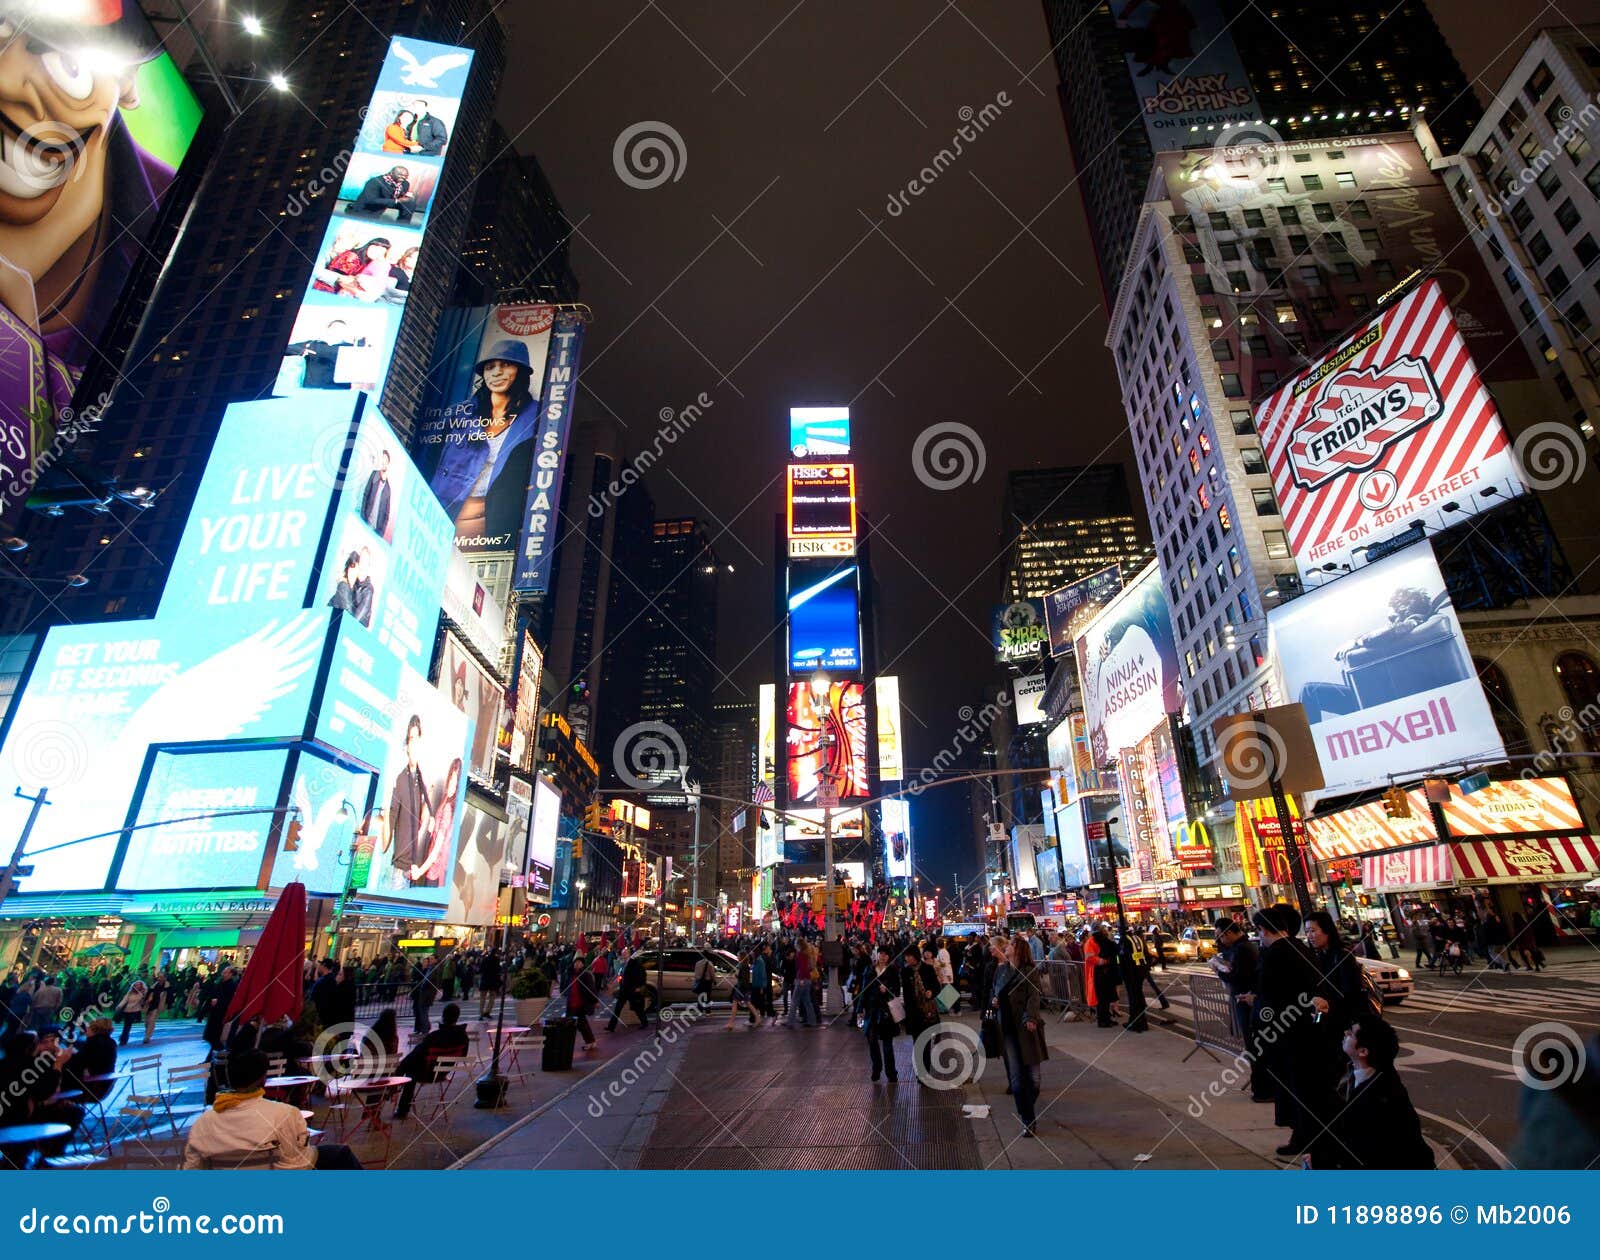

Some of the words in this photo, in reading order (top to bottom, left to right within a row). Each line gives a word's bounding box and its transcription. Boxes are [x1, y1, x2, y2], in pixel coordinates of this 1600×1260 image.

[1157, 73, 1228, 97] MARY
[1144, 87, 1250, 115] POPPINS
[1153, 119, 1176, 129] ON
[1180, 112, 1254, 127] BROADWAY
[547, 333, 575, 420] TIMES
[455, 404, 474, 415] PC
[1337, 399, 1362, 418] T.G.I.
[423, 419, 449, 431] and
[449, 415, 505, 429] Windows
[509, 414, 517, 426] 7
[419, 433, 442, 444] was
[445, 432, 465, 446] my
[230, 462, 320, 505] LIVE
[793, 468, 828, 479] HSBC
[525, 431, 559, 556] SQUARE
[1308, 536, 1345, 561] HERE
[1349, 523, 1370, 542] ON
[1375, 503, 1415, 529] 46TH
[1419, 466, 1482, 508] STREET
[200, 510, 308, 555] YOUR
[503, 534, 511, 544] 7
[792, 542, 828, 553] HSBC
[207, 560, 297, 605] LIFE
[1000, 625, 1047, 647] SHREK
[56, 643, 98, 666] GET
[103, 639, 161, 662] YOUR
[830, 648, 855, 657] JACK
[1005, 640, 1040, 657] MUSIC
[49, 669, 76, 692] 15
[77, 661, 182, 689] SECONDS
[1106, 659, 1139, 693] NINJA
[1104, 668, 1158, 718] ASSASSIN
[1325, 696, 1456, 761] maxell
[1128, 755, 1150, 841] PALACE
[1512, 854, 1548, 863] FRIDAY'S
[151, 900, 225, 912] AMERICAN
[228, 901, 273, 912] EAGLE
